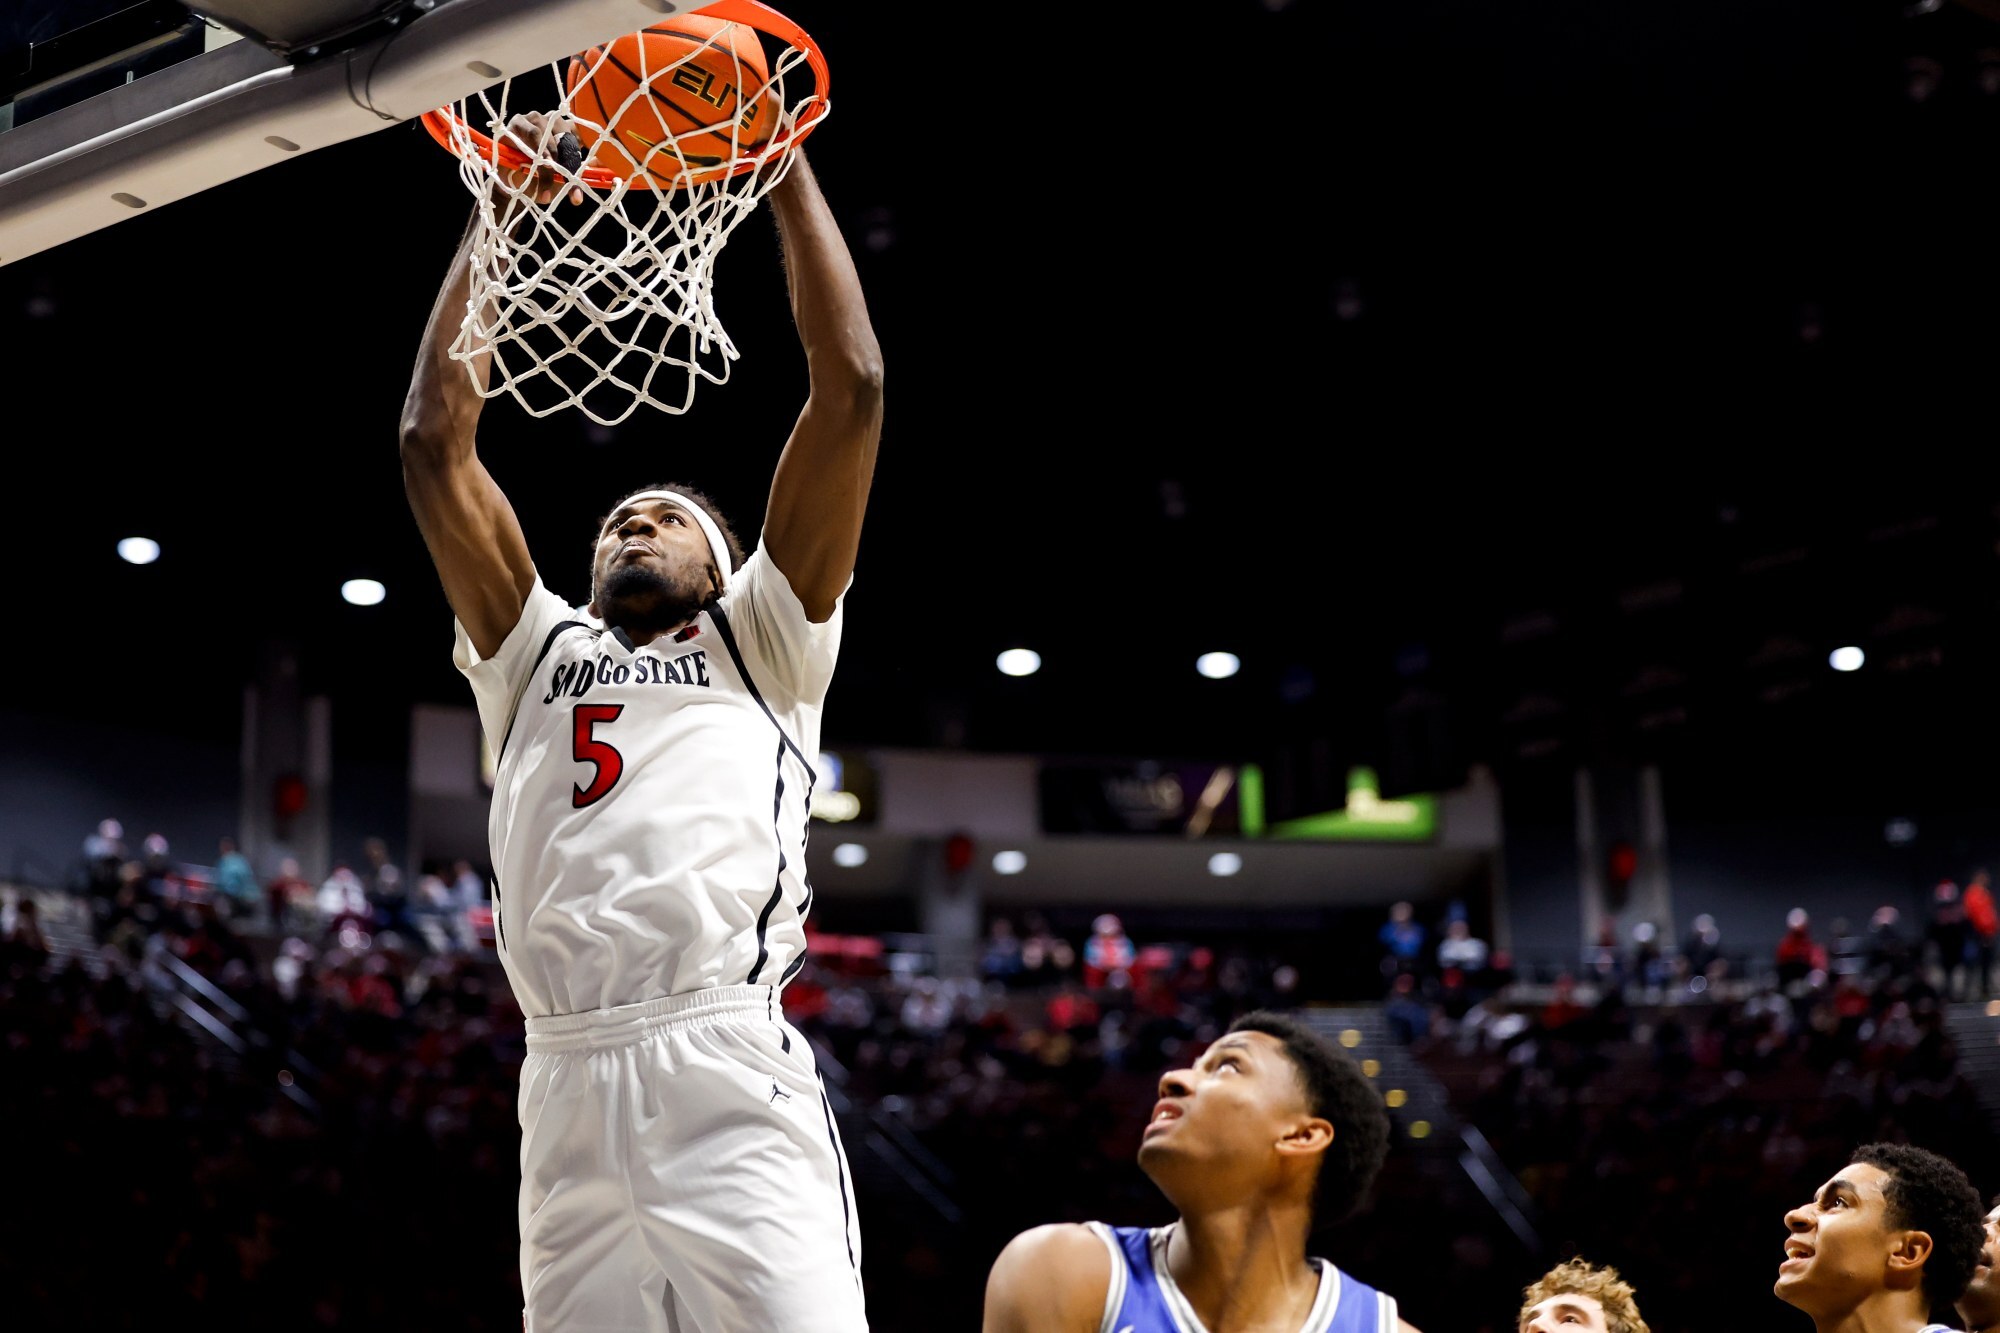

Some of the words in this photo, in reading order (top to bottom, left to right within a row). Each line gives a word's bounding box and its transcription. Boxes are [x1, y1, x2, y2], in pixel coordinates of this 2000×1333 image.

[570, 653, 630, 697] DGO
[634, 651, 710, 687] STATE
[572, 703, 625, 809] 5
